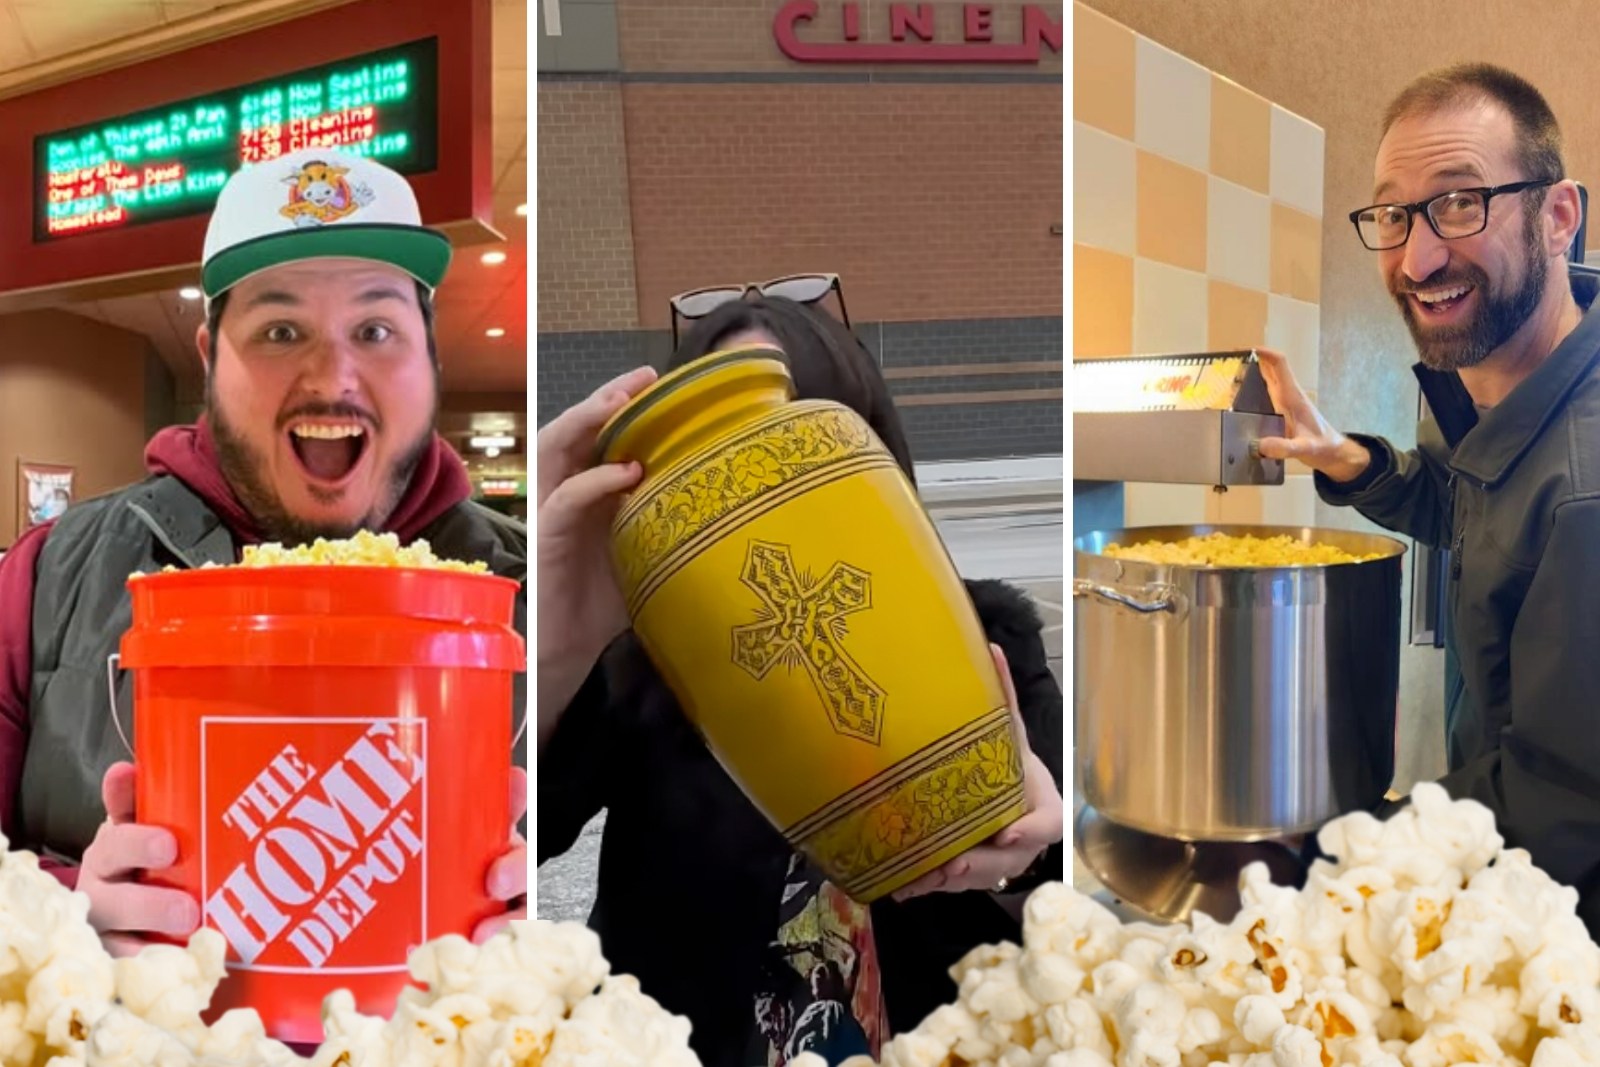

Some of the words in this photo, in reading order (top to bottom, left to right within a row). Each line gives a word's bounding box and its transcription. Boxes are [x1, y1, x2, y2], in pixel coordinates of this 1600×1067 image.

[80, 133, 98, 150] of
[104, 120, 165, 145] Thieves
[195, 106, 226, 125] Pan
[241, 88, 282, 114] 6:40
[289, 82, 322, 101] Now
[329, 60, 407, 95] Seating
[113, 143, 139, 160] The
[187, 122, 225, 144] Anni
[289, 101, 322, 121] Now
[329, 81, 407, 111] Seating
[241, 125, 281, 147] 7:20
[290, 105, 375, 137] Cleaning
[49, 187, 74, 203] One
[80, 181, 97, 196] of
[241, 143, 281, 162] 7:30
[290, 124, 375, 153] Cleaning
[112, 189, 139, 205] The
[144, 181, 182, 201] Lion
[187, 171, 227, 192] King
[49, 207, 123, 233] Homestead
[222, 743, 317, 842] THE
[206, 720, 424, 965] HOME
[286, 809, 423, 970] DEPOT
